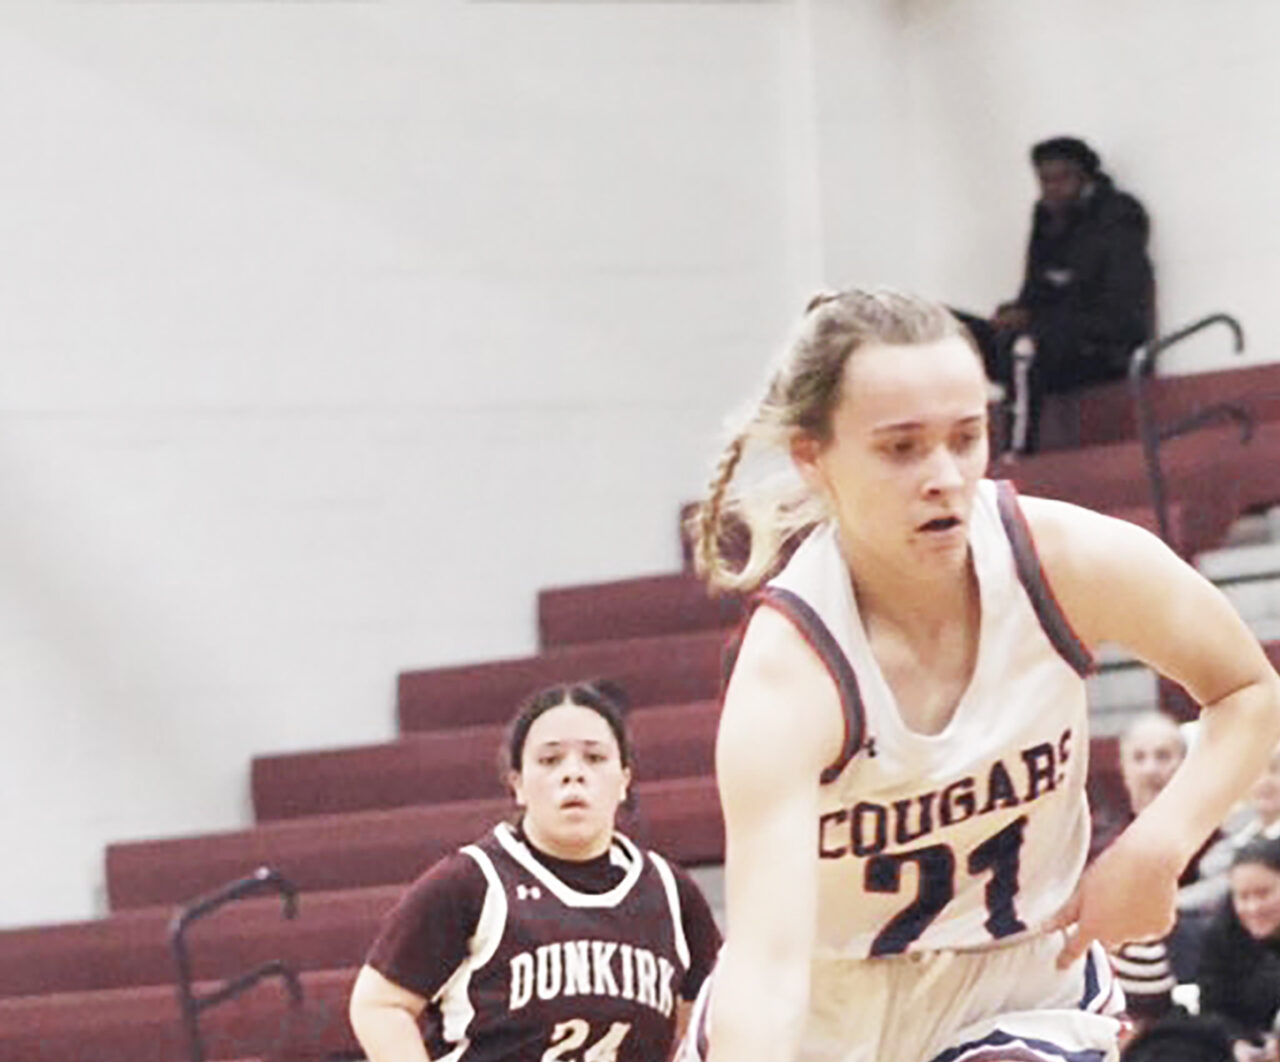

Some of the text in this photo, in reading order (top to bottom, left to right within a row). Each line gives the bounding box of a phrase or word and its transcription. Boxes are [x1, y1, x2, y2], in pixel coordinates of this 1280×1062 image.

[818, 728, 1072, 859] COUGARS
[863, 814, 1028, 959] 21
[509, 939, 675, 1018] DUNKIRK
